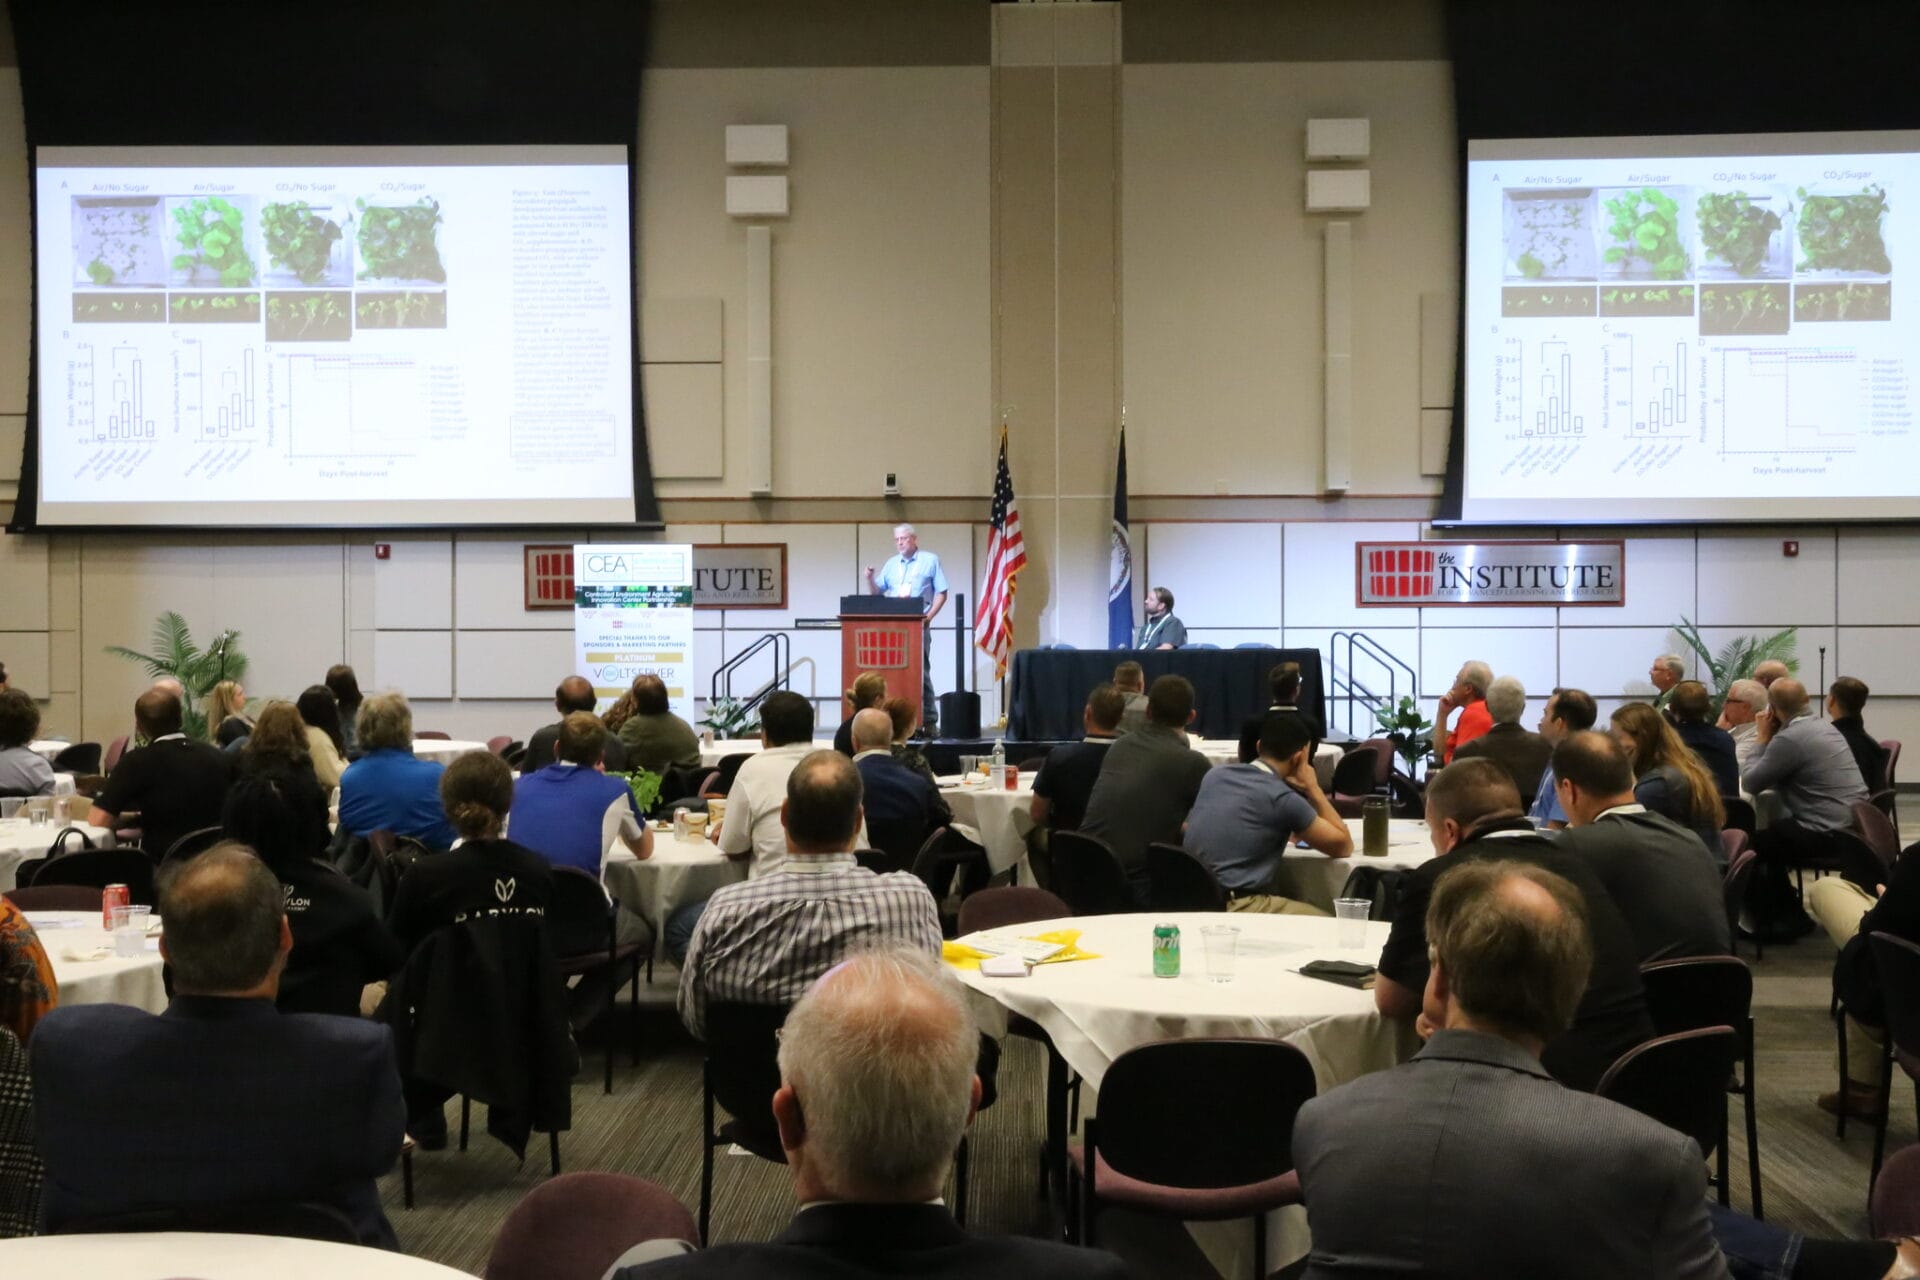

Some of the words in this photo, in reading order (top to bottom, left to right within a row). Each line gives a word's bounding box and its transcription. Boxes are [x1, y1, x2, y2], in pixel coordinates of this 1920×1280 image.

[1492, 173, 1500, 182] A
[1524, 176, 1553, 184] Air/No
[1554, 176, 1583, 184] Sugar
[1628, 174, 1672, 184] Air/Sugar
[1750, 172, 1776, 182] Sugar
[122, 183, 150, 192] Sugar
[1602, 324, 1610, 333] C
[1698, 338, 1706, 346] D
[1438, 552, 1455, 564] the
[588, 556, 628, 572] CEA
[1438, 565, 1614, 589] INSTITUTE
[1456, 588, 1502, 596] AVANCED
[614, 654, 656, 662] PLATINUM
